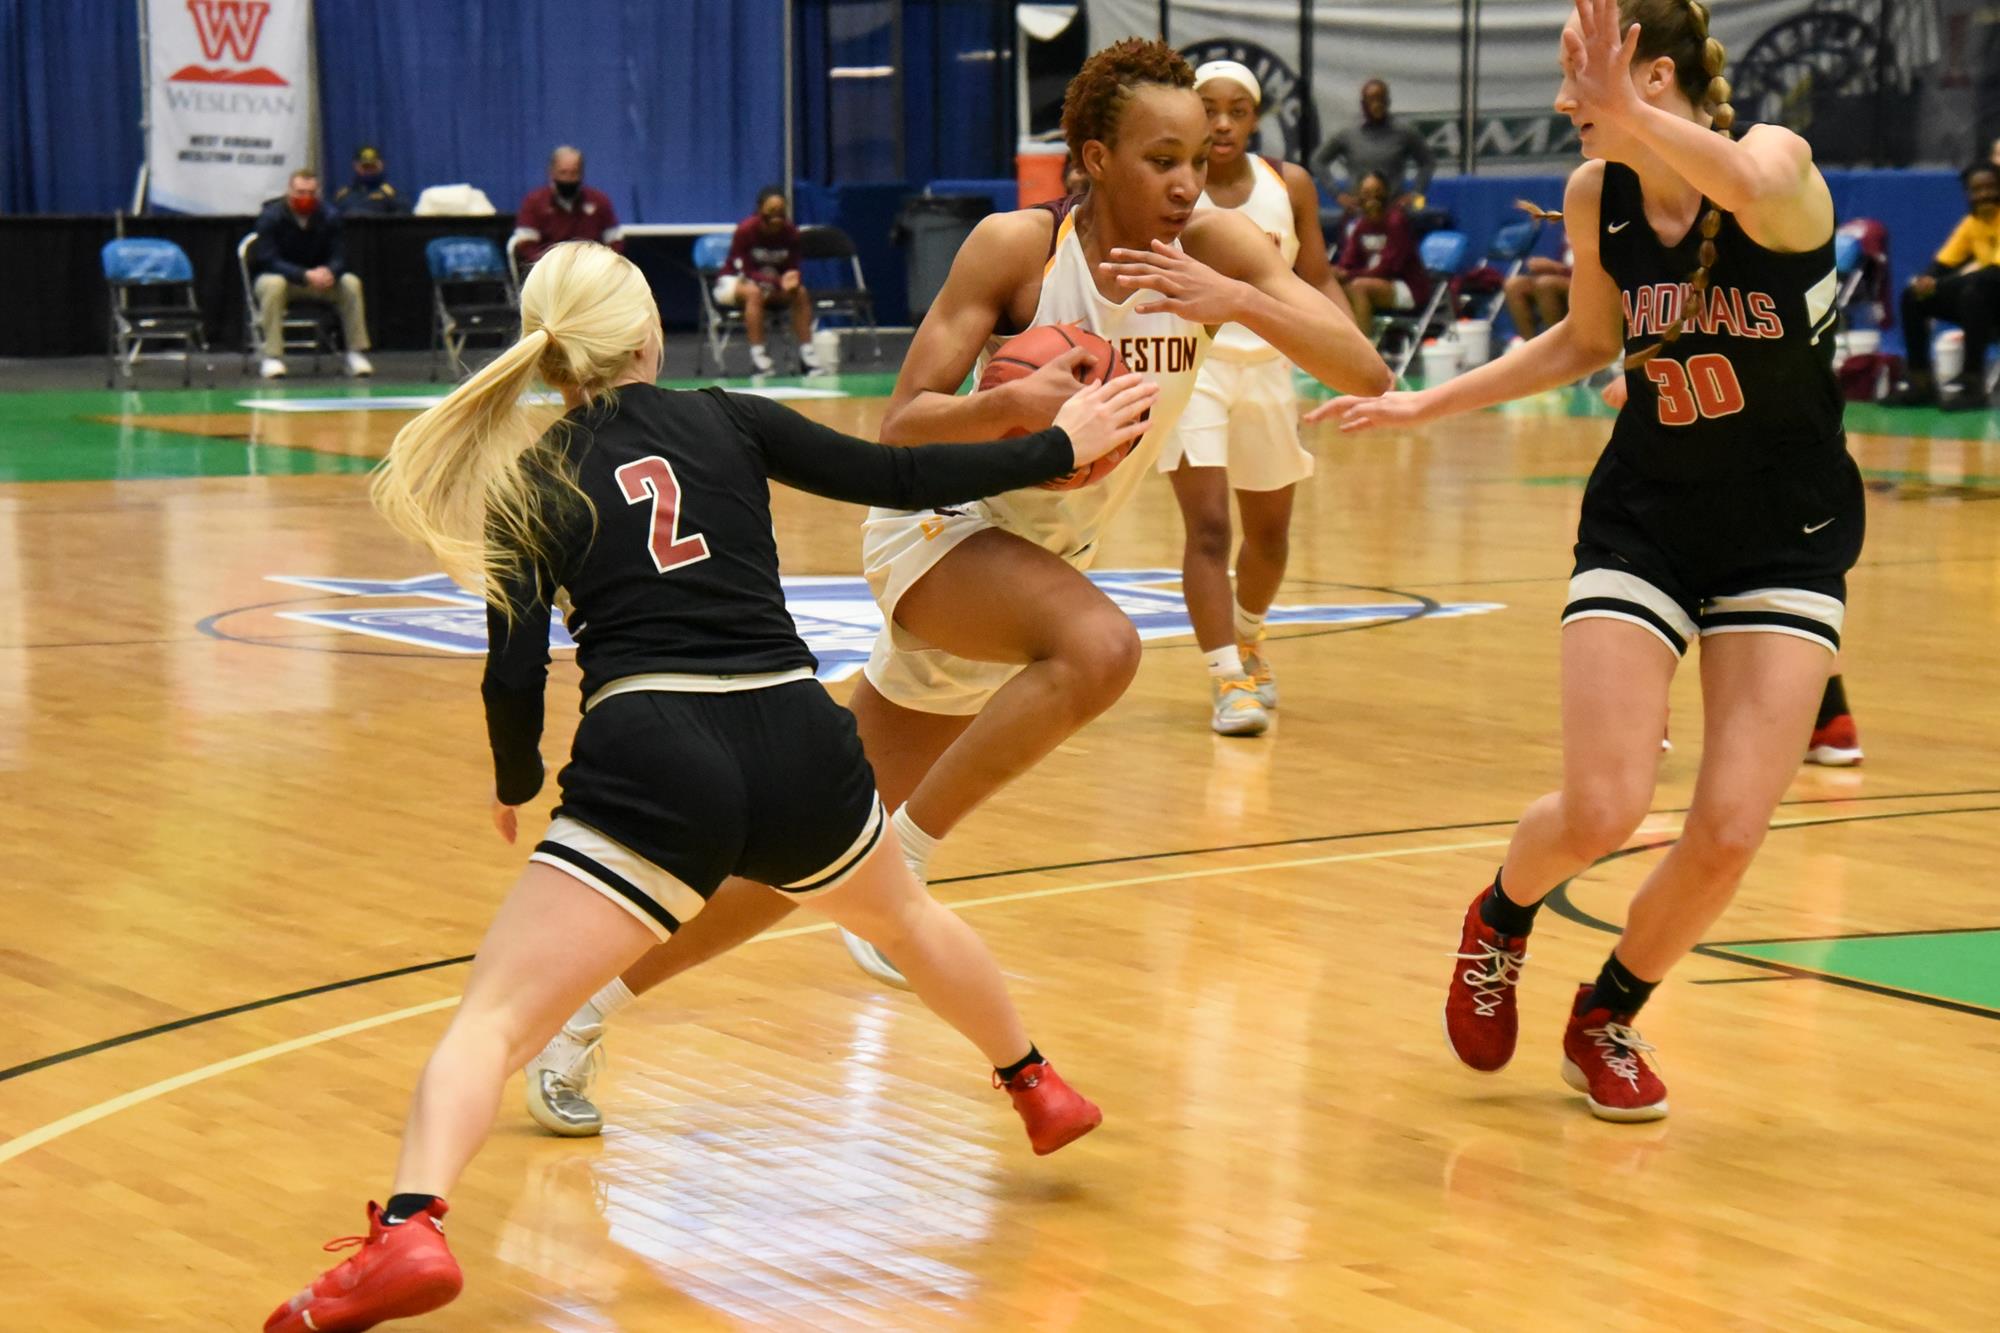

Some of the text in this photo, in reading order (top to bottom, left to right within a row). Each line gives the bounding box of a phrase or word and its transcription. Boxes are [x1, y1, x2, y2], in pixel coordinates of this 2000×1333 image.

[186, 0, 271, 61] W
[165, 86, 296, 115] WESLEYAN
[1622, 282, 1784, 339] ARDINALS
[1120, 335, 1198, 374] ESTON
[1645, 353, 1745, 426] 30
[614, 455, 711, 574] 2
